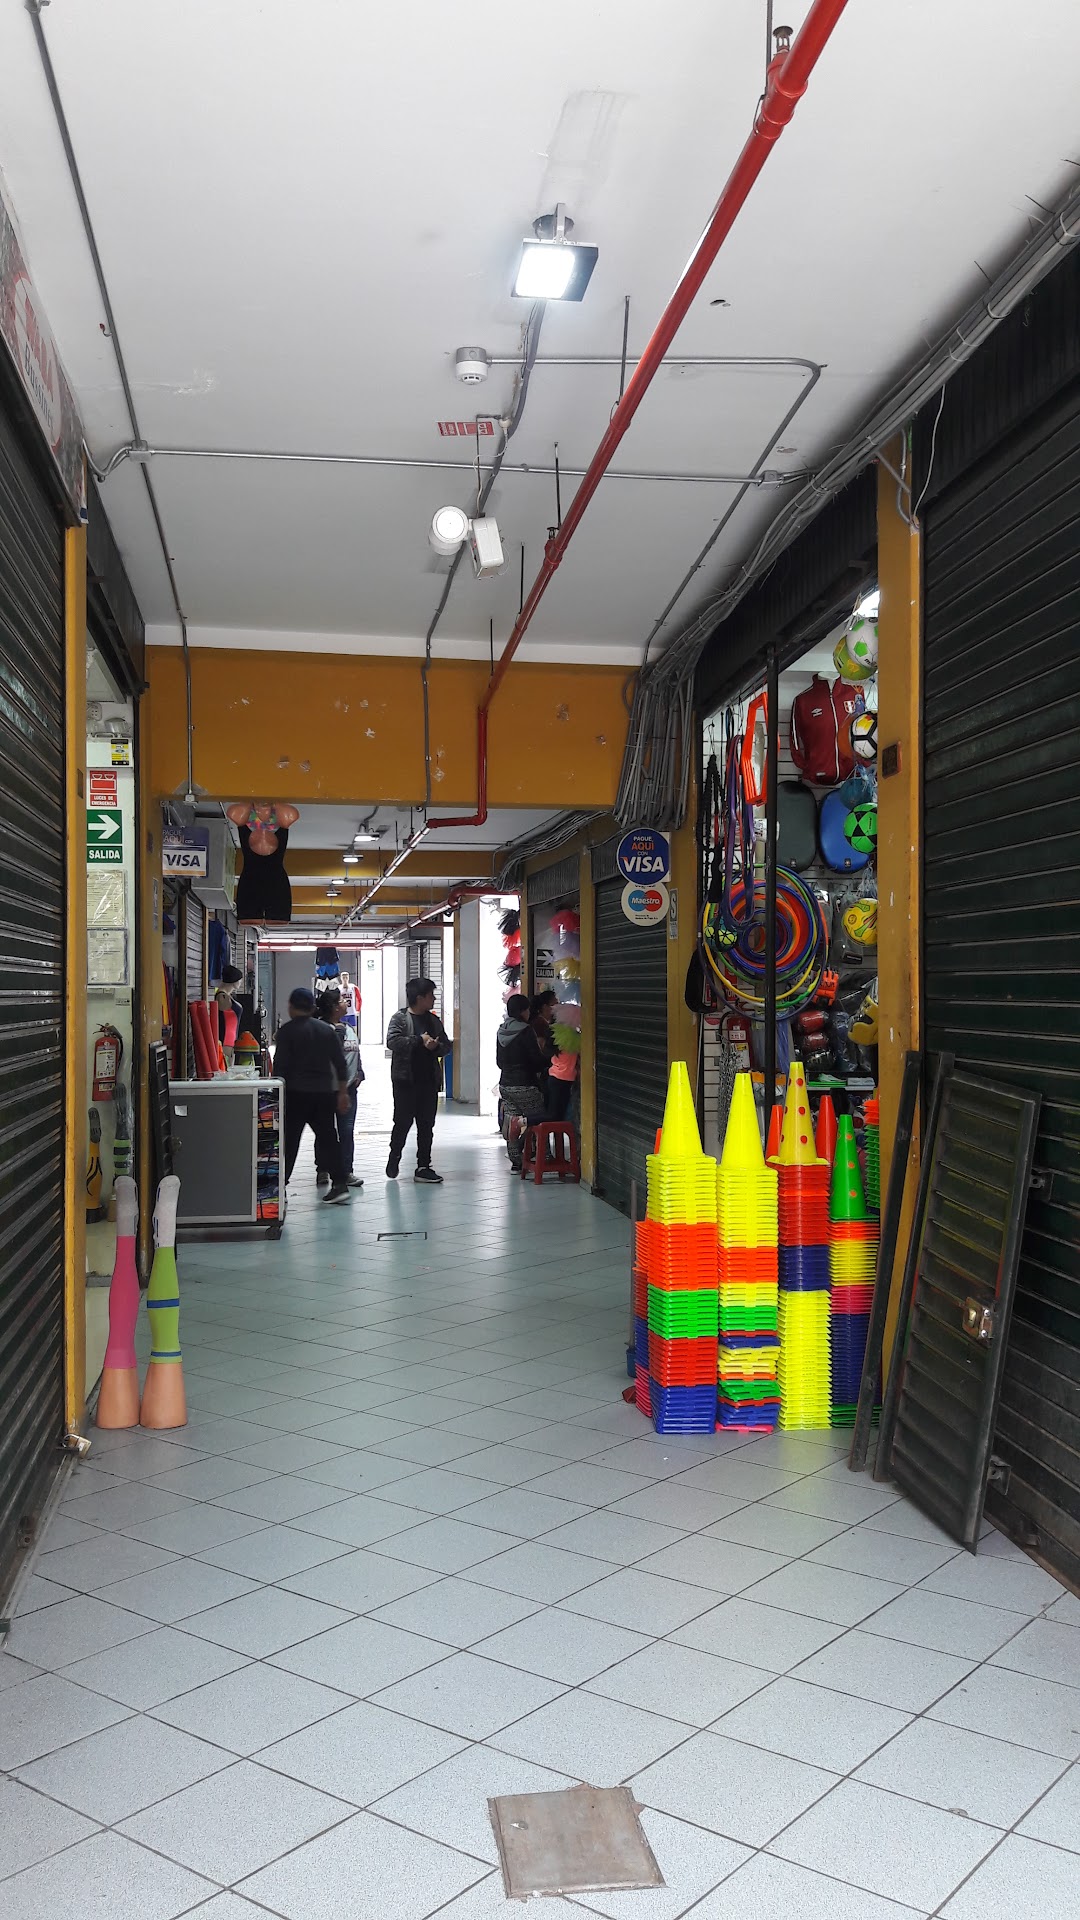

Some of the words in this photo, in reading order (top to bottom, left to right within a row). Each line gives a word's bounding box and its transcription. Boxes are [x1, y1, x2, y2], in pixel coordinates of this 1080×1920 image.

[88, 849, 121, 859] SALIDA
[163, 853, 201, 867] VISA
[620, 856, 665, 873] VISA
[631, 896, 661, 905] Maestro
[536, 968, 555, 978] SALIDA
